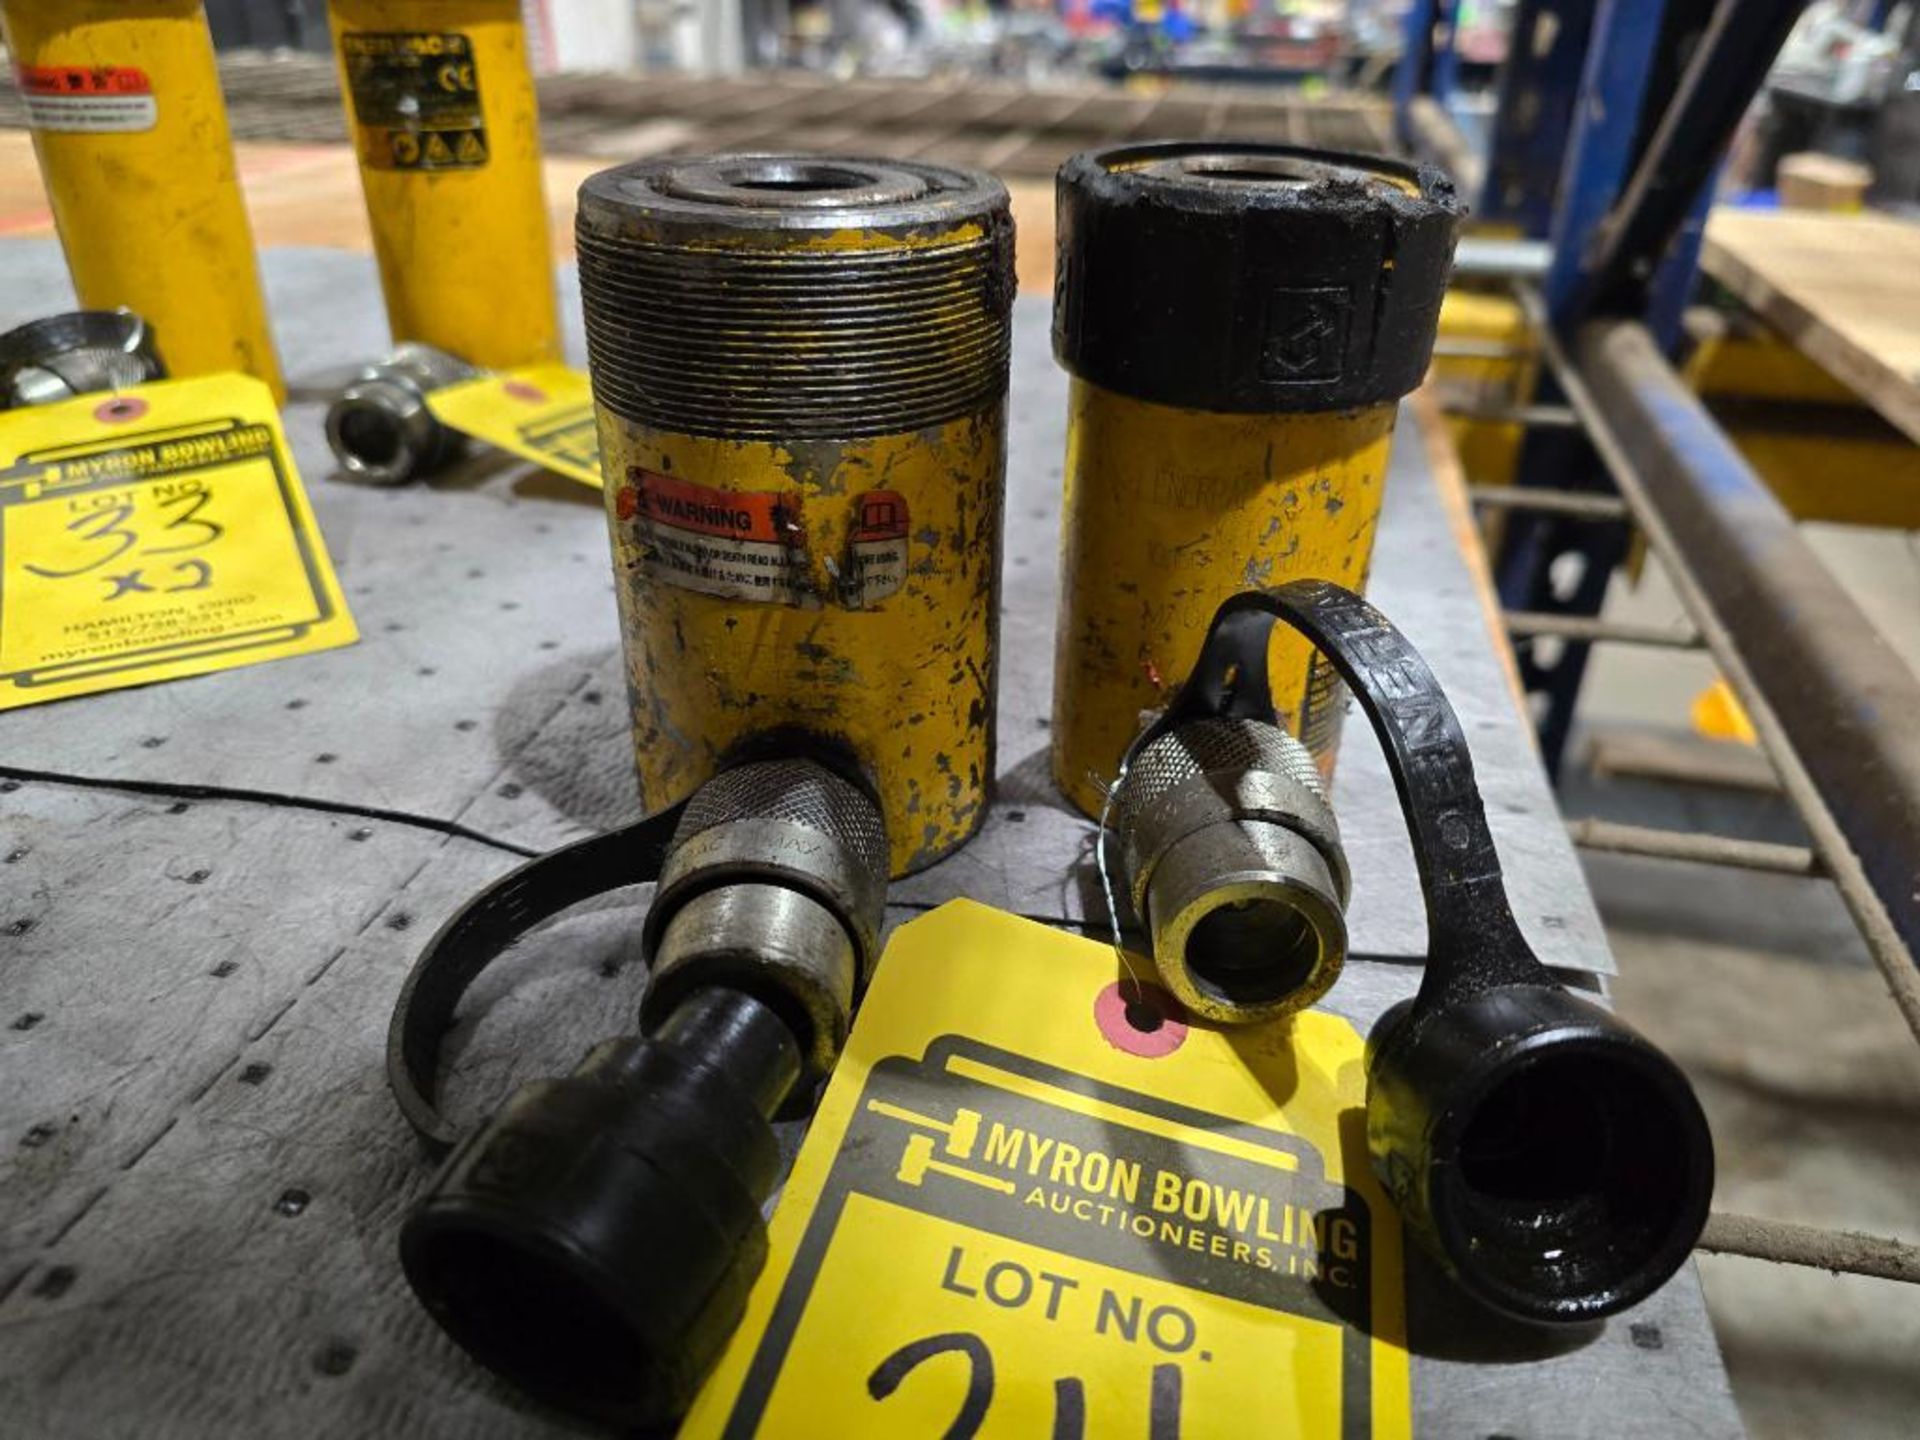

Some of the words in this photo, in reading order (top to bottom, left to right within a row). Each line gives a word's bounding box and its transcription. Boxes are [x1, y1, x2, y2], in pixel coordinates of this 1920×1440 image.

[67, 450, 156, 480] MYRON
[160, 428, 271, 465] BOWLING
[23, 488, 225, 578] 33
[69, 489, 137, 513] LOT
[656, 493, 752, 530] WARNING
[985, 1121, 1142, 1203] MYRON
[1152, 1171, 1357, 1262] BOWLING
[1025, 1186, 1280, 1272] AUCTIONEERS,
[1289, 1252, 1357, 1290] INC.
[941, 1246, 1079, 1320] LOT
[1095, 1290, 1214, 1362] NO.
